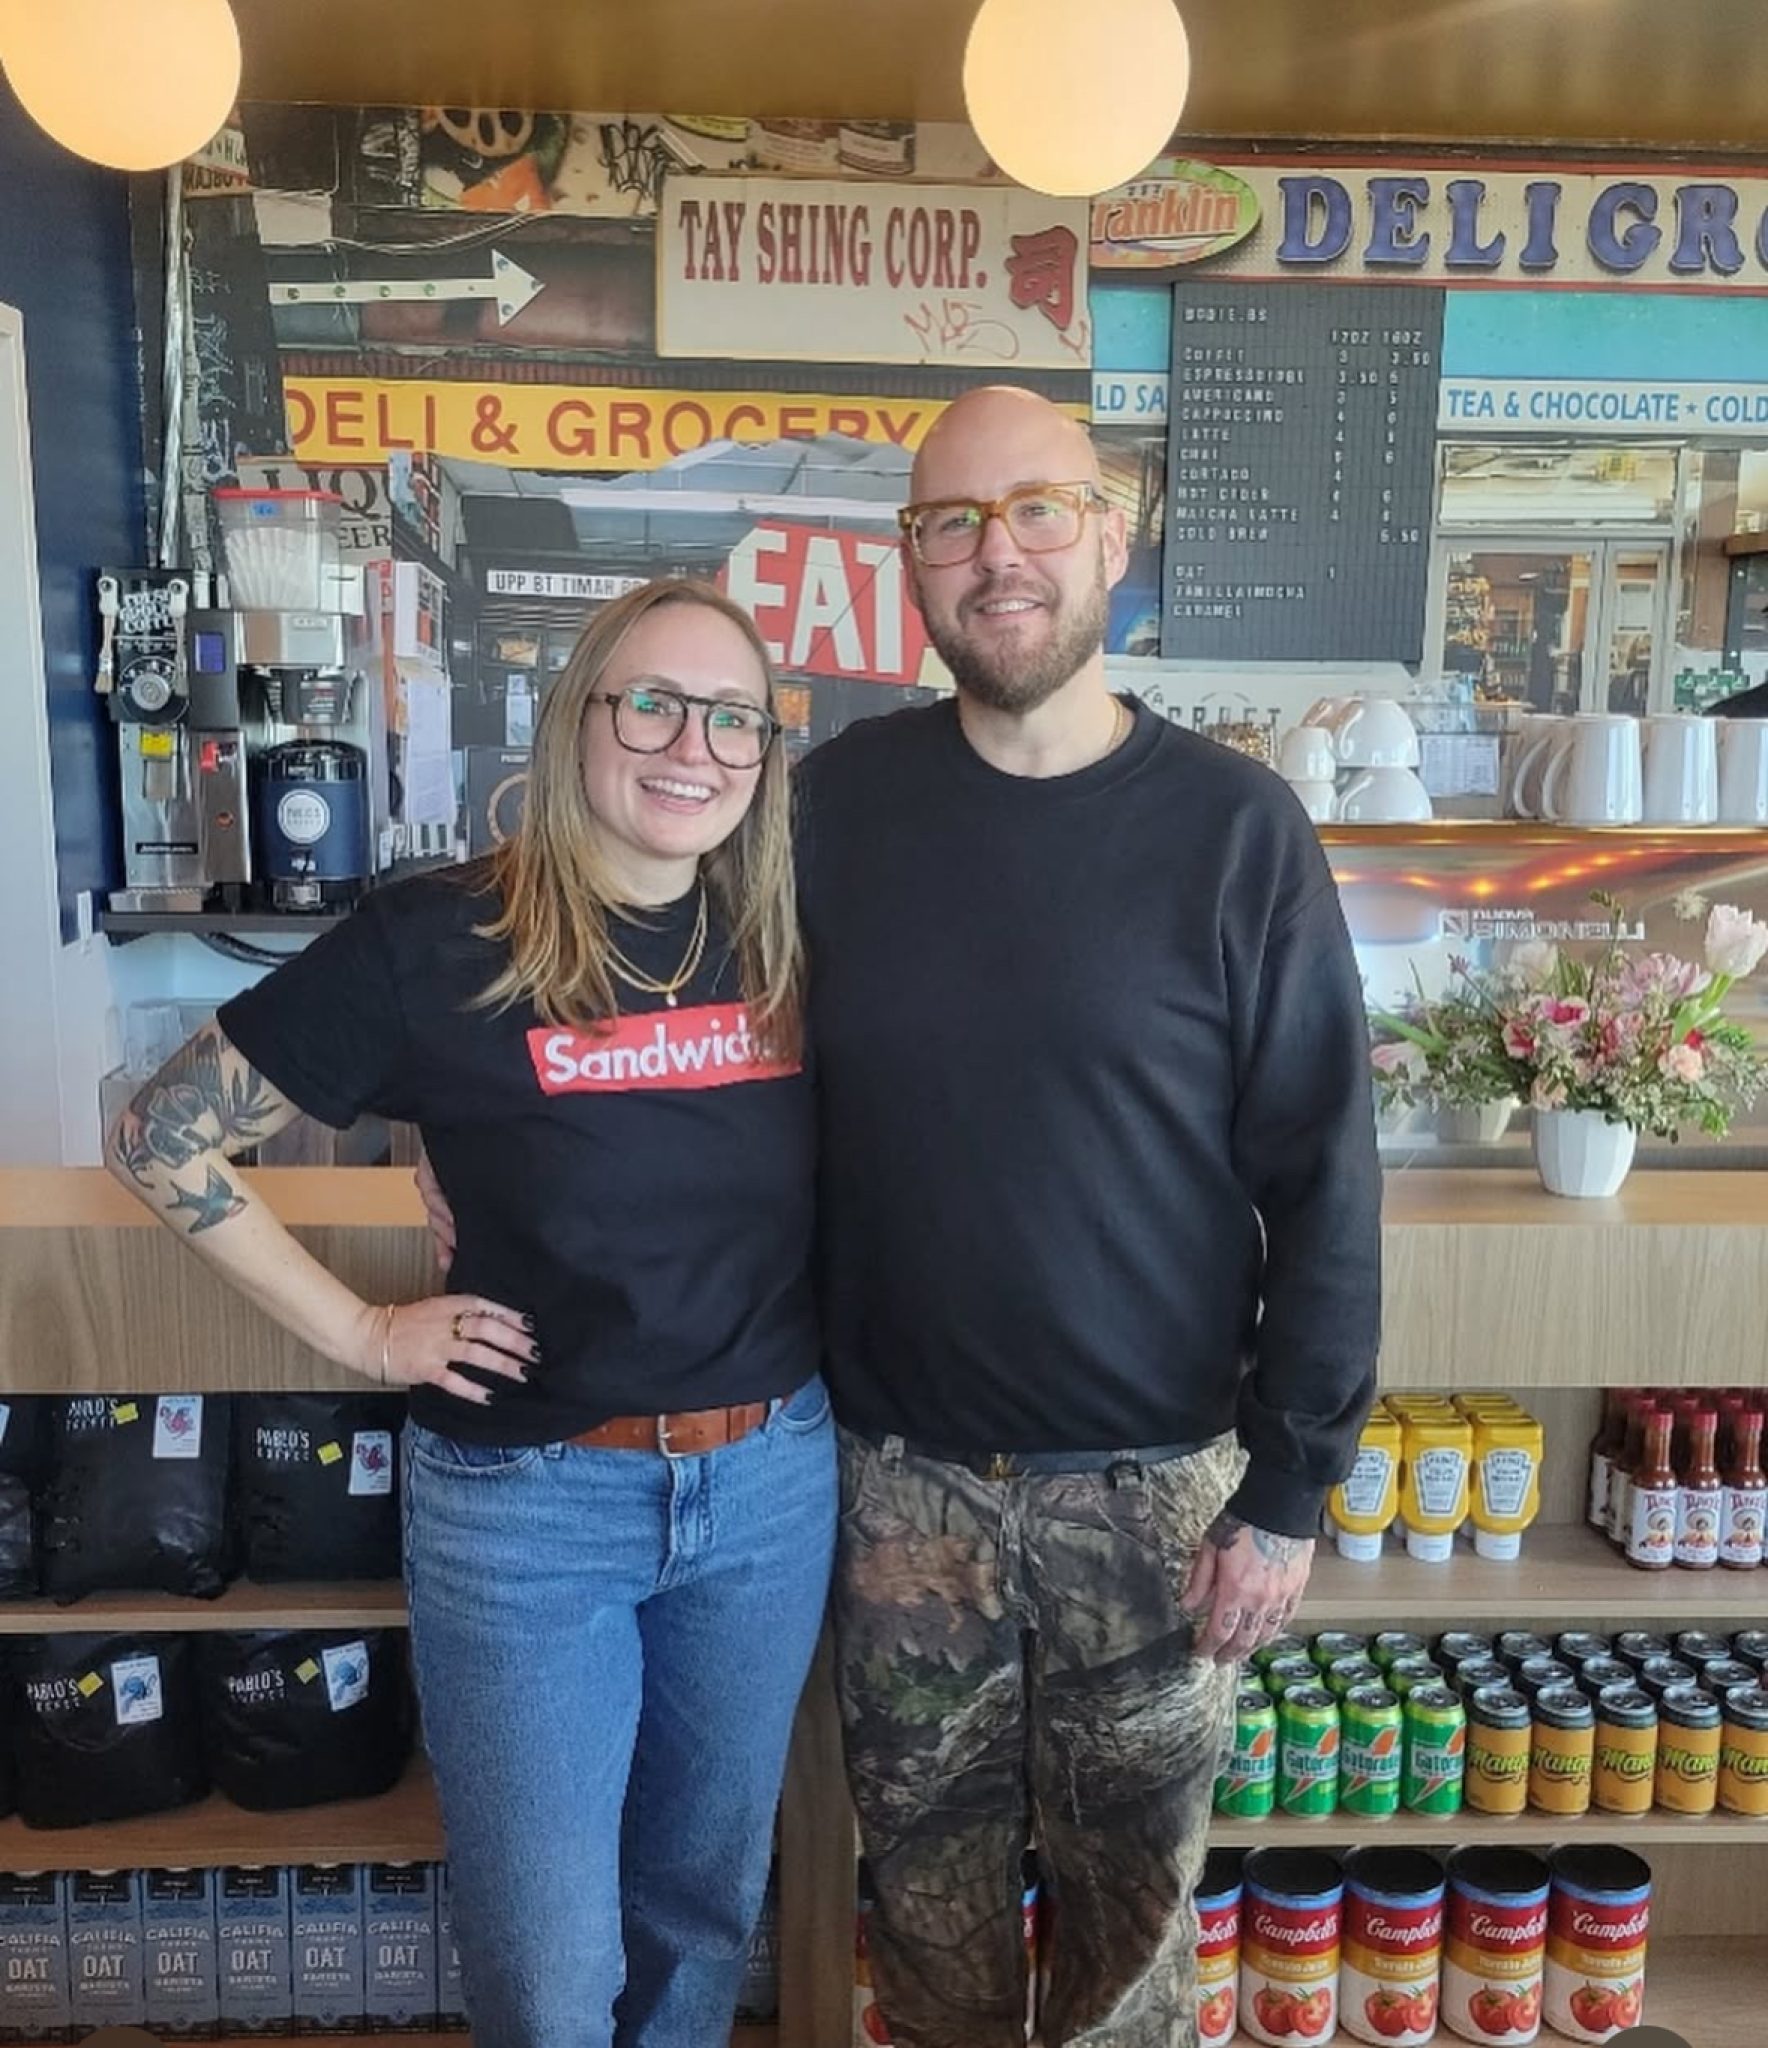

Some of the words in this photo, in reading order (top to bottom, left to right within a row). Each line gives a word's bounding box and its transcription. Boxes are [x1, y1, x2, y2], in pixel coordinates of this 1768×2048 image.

[1276, 175, 1560, 269] DELI
[1587, 182, 1768, 273] GR
[679, 200, 747, 282] TAY
[757, 202, 873, 287] SHING
[884, 207, 988, 288] CORP.
[1447, 389, 1495, 418] TEA
[1504, 391, 1520, 418] &
[1529, 390, 1679, 422] CHOCOLATE
[470, 396, 519, 455] &
[1181, 428, 1231, 442] LATTE
[496, 574, 526, 592] UPP
[533, 576, 553, 593] BT
[561, 578, 615, 595] TIMAH
[728, 527, 904, 674] EAT
[71, 1929, 136, 1945] CALIFIA
[146, 1926, 210, 1941] CALIFIA
[219, 1924, 284, 1939] CALIFIA
[296, 1921, 358, 1936] CALIFIA
[368, 1919, 431, 1935] CALIFIA
[83, 1954, 124, 1978] OAT
[158, 1951, 198, 1974] OAT
[231, 1949, 272, 1972] OAT
[305, 1947, 346, 1969] OAT
[378, 1945, 419, 1968] OAT
[8, 1958, 49, 1980] OAT
